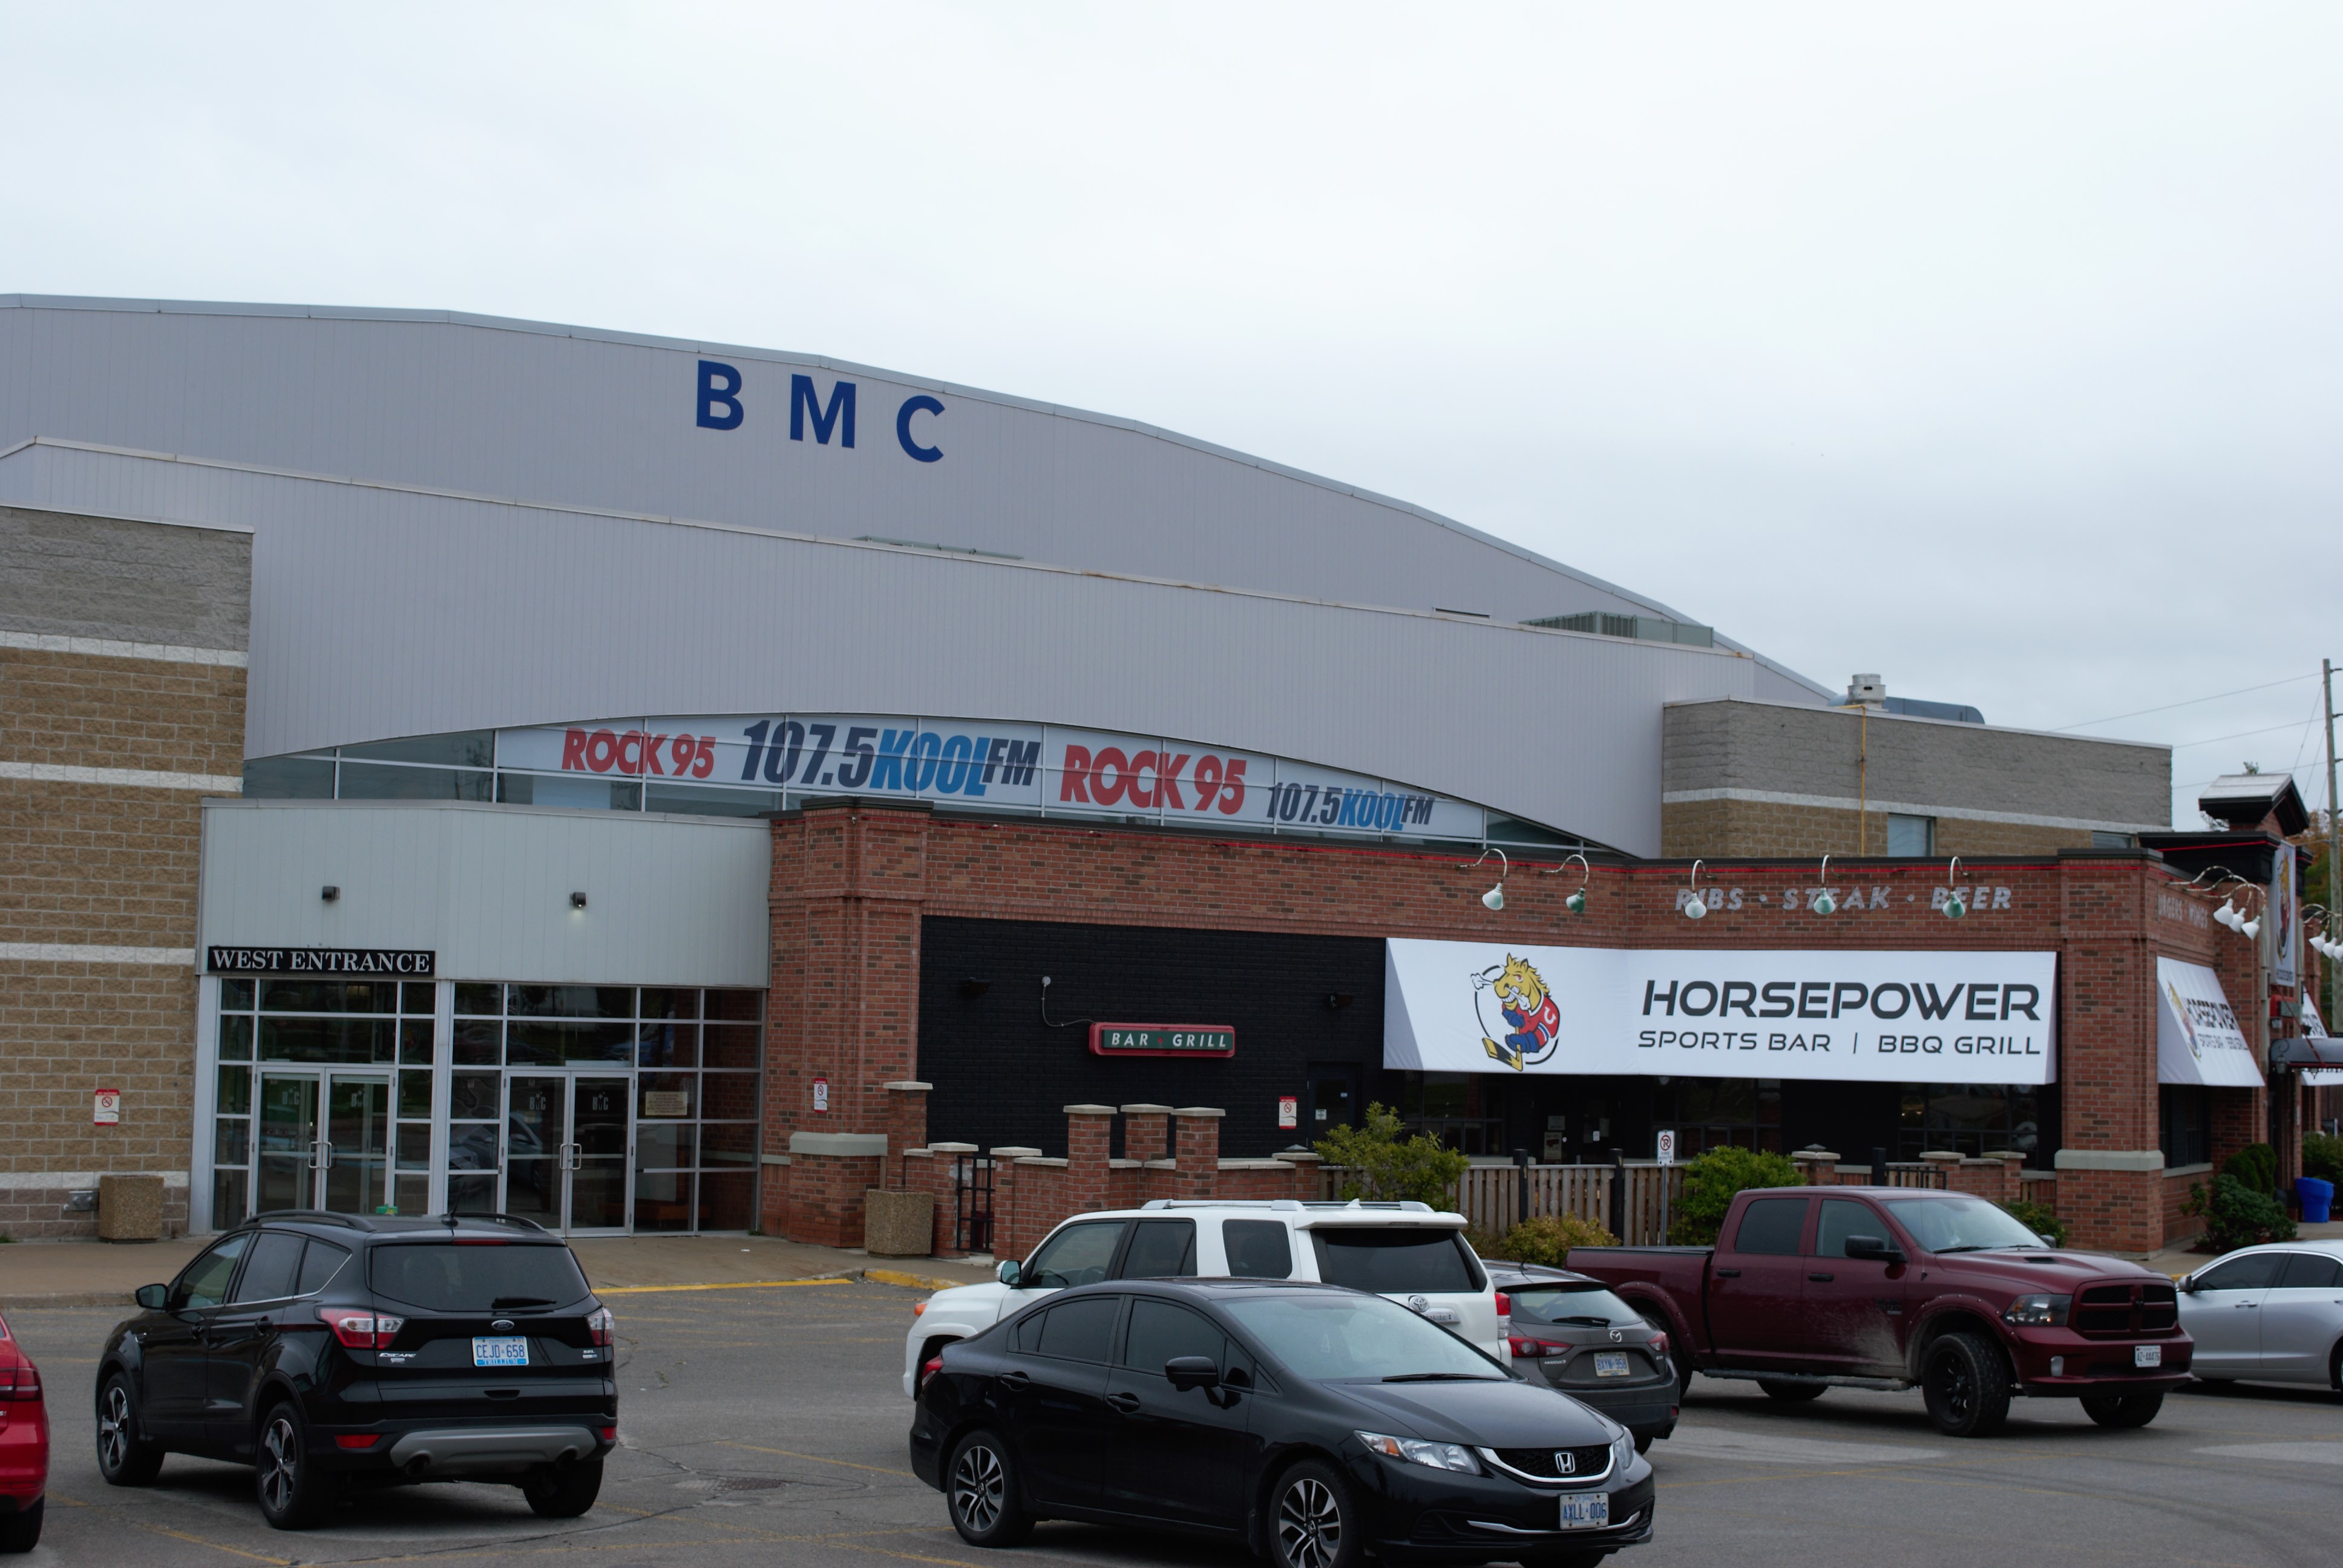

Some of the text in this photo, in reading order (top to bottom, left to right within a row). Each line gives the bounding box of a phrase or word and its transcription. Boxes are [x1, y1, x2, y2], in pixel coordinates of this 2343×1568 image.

[562, 727, 716, 779] ROCK 95
[1060, 744, 1247, 815] ROCK 95
[1675, 886, 2011, 910] RIBS STEAK BEER
[213, 949, 430, 973] WEST ENTRANCE
[1642, 980, 2040, 1021] HORSEPOWER
[1112, 1033, 1227, 1048] BAR GRILL
[1638, 1030, 2040, 1055] SPORTS BAR BBQ GRILL
